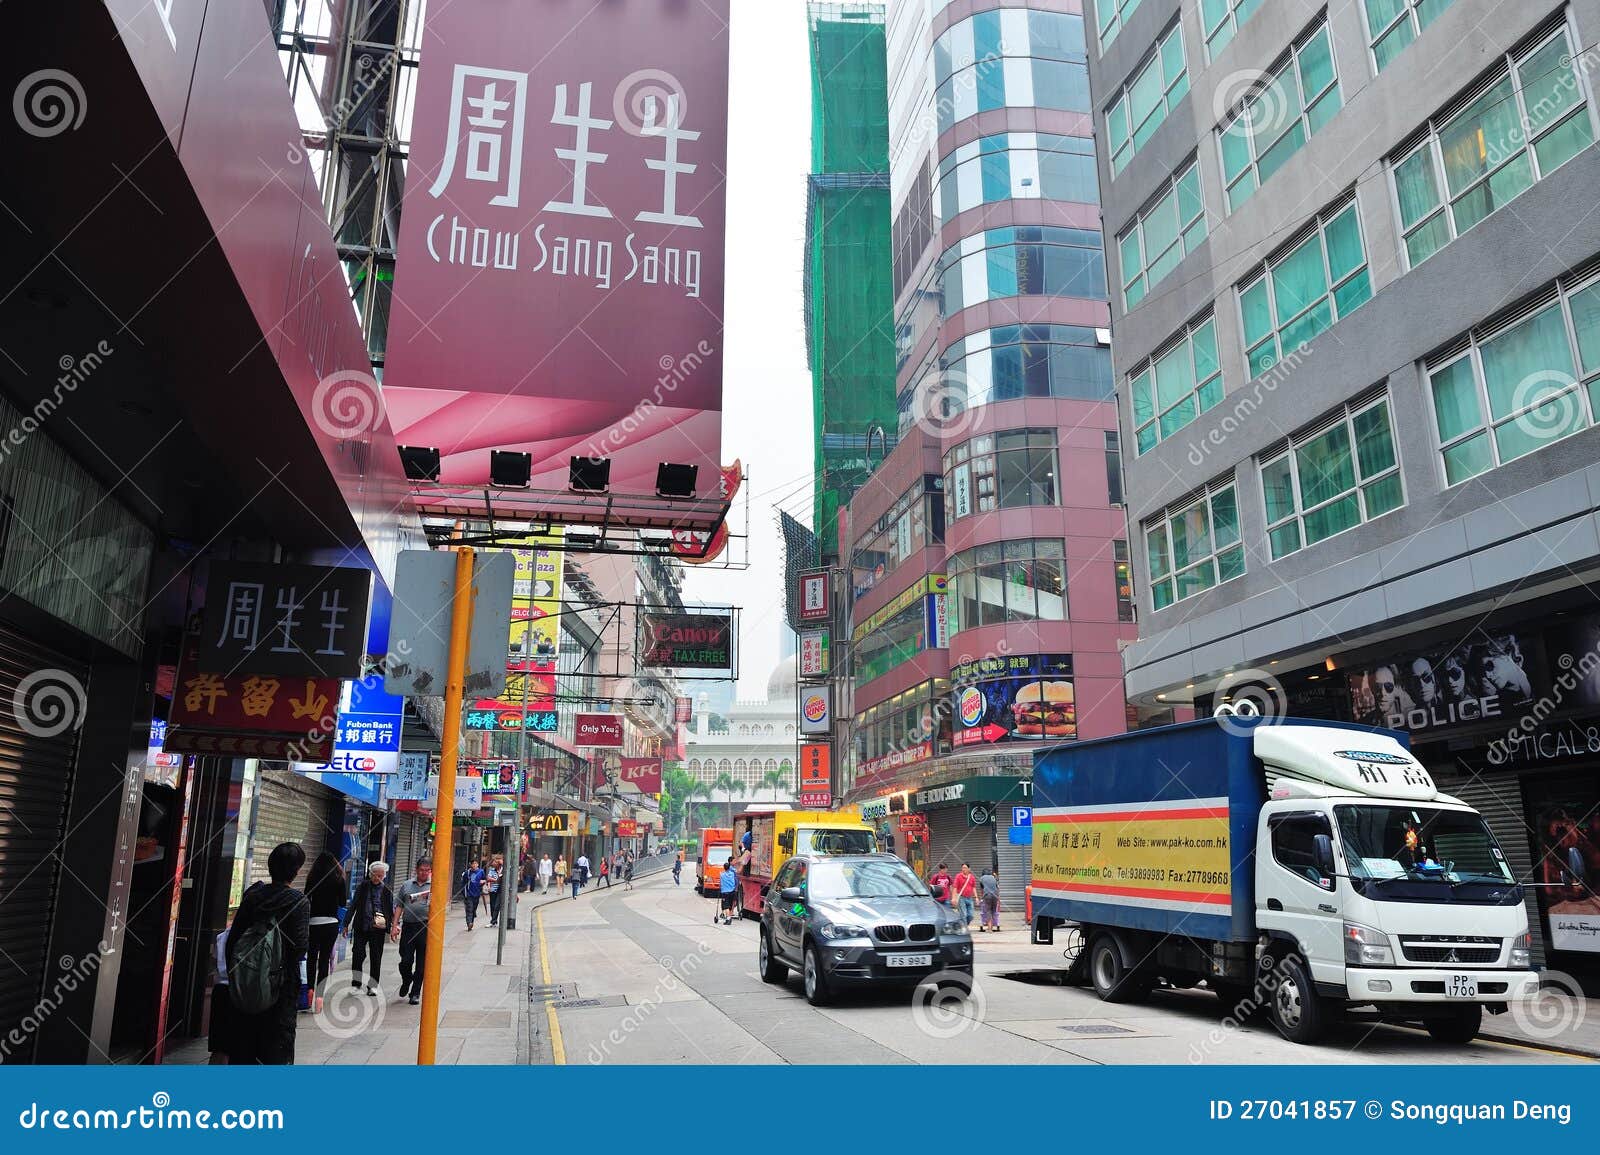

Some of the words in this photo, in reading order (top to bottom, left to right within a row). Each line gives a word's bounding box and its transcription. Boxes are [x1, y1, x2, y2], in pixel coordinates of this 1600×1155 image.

[428, 63, 704, 228] 周生生
[426, 213, 520, 271] Chow
[533, 223, 612, 289] Sang
[624, 232, 701, 298] Sang
[527, 561, 555, 572] Paza
[216, 581, 349, 656] 周生生
[655, 623, 720, 643] Canon
[674, 649, 696, 663] TAX
[699, 650, 726, 663] FREE
[184, 673, 329, 721] 許留山
[806, 703, 826, 717] KING
[1387, 694, 1501, 730] POLICE
[346, 720, 372, 729] Fubon
[372, 721, 393, 729] Bank
[581, 725, 599, 734] Only
[601, 725, 615, 733] You
[1488, 730, 1585, 764] OPTICAL
[627, 763, 660, 779] KFC
[945, 784, 964, 801] SHOP
[545, 814, 562, 830] M
[1016, 809, 1029, 825] P
[1042, 832, 1102, 849] 柏高貨運公司
[1117, 837, 1131, 847] Web
[1033, 863, 1045, 874] Pak
[1045, 864, 1054, 874] Ko
[1055, 864, 1100, 879] Transportation
[1168, 868, 1229, 886] Fax:27789668
[891, 957, 904, 966] FS
[908, 956, 927, 965] 992
[1453, 975, 1469, 986] PP
[1448, 985, 1475, 997] 1700
